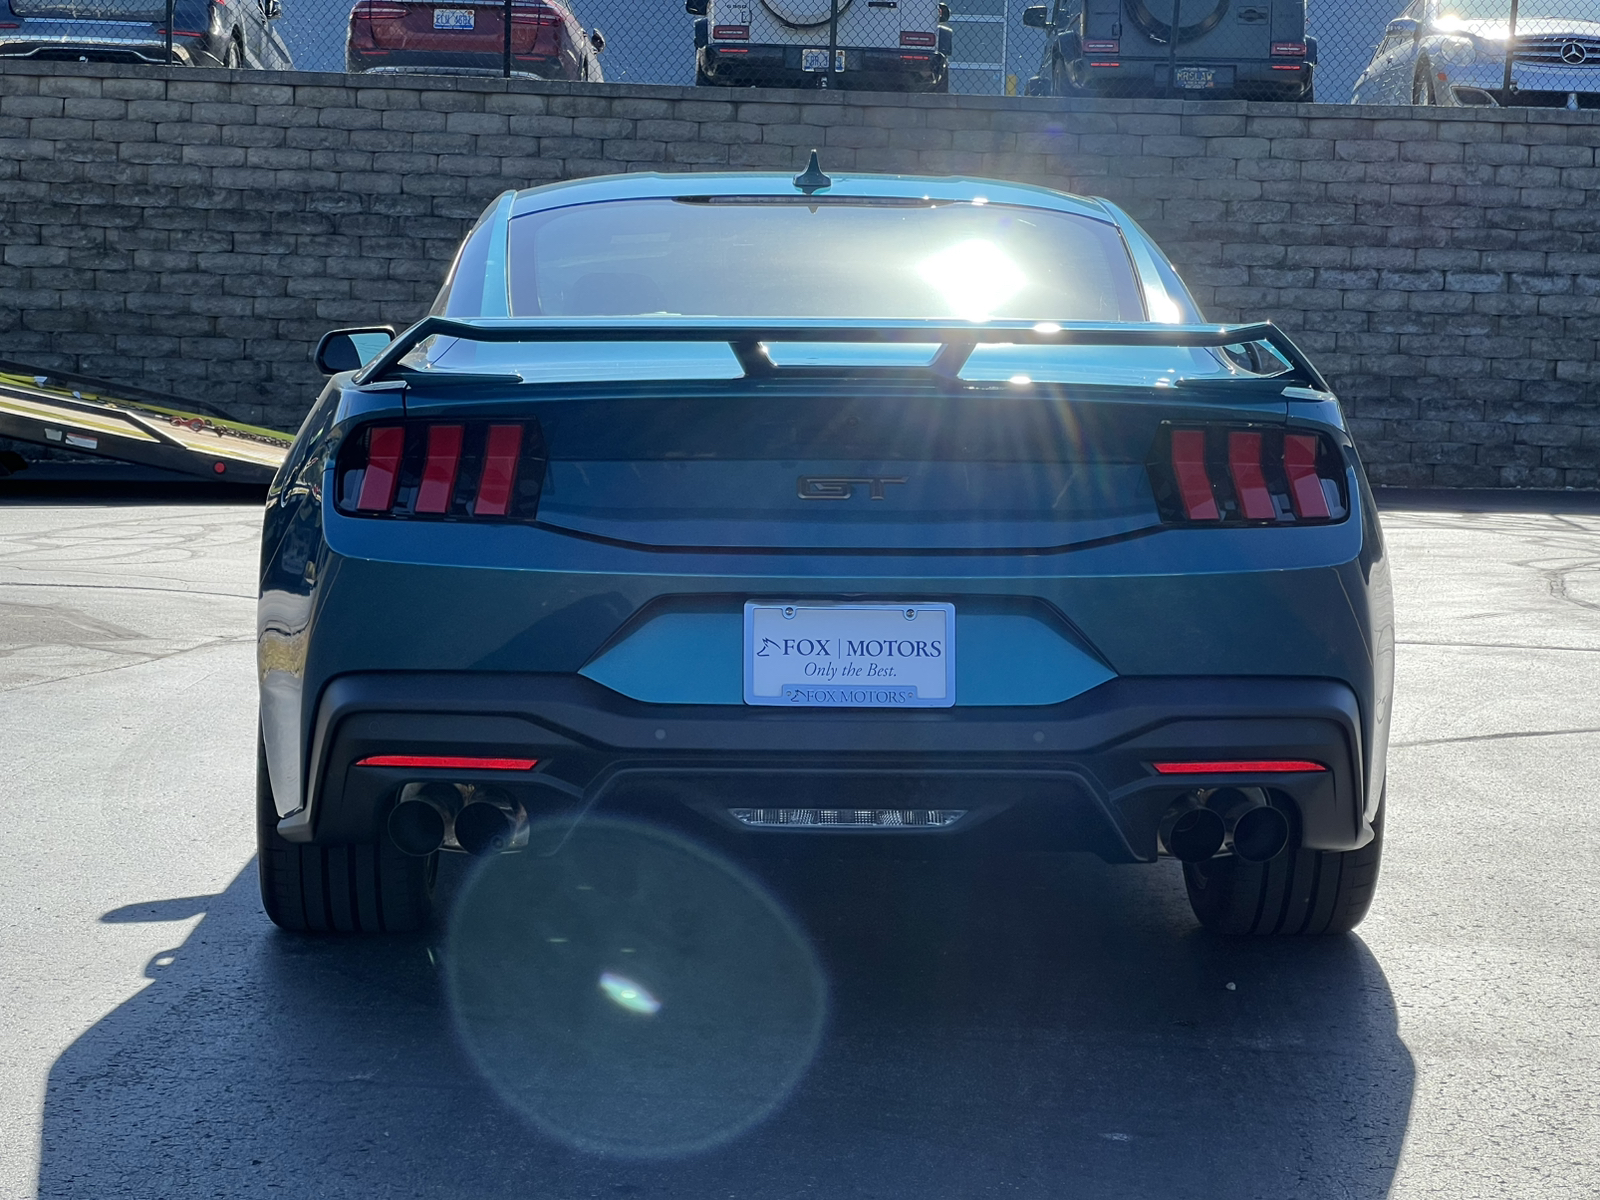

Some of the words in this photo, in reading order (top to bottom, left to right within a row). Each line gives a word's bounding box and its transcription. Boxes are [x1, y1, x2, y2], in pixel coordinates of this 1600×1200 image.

[796, 474, 909, 501] GT
[782, 638, 831, 657] FOX
[846, 639, 942, 658] MOTORS
[804, 661, 838, 681] Only
[841, 662, 863, 678] the
[866, 662, 897, 678] Best.
[806, 690, 835, 703] FOX
[839, 690, 906, 704] MOTORS
